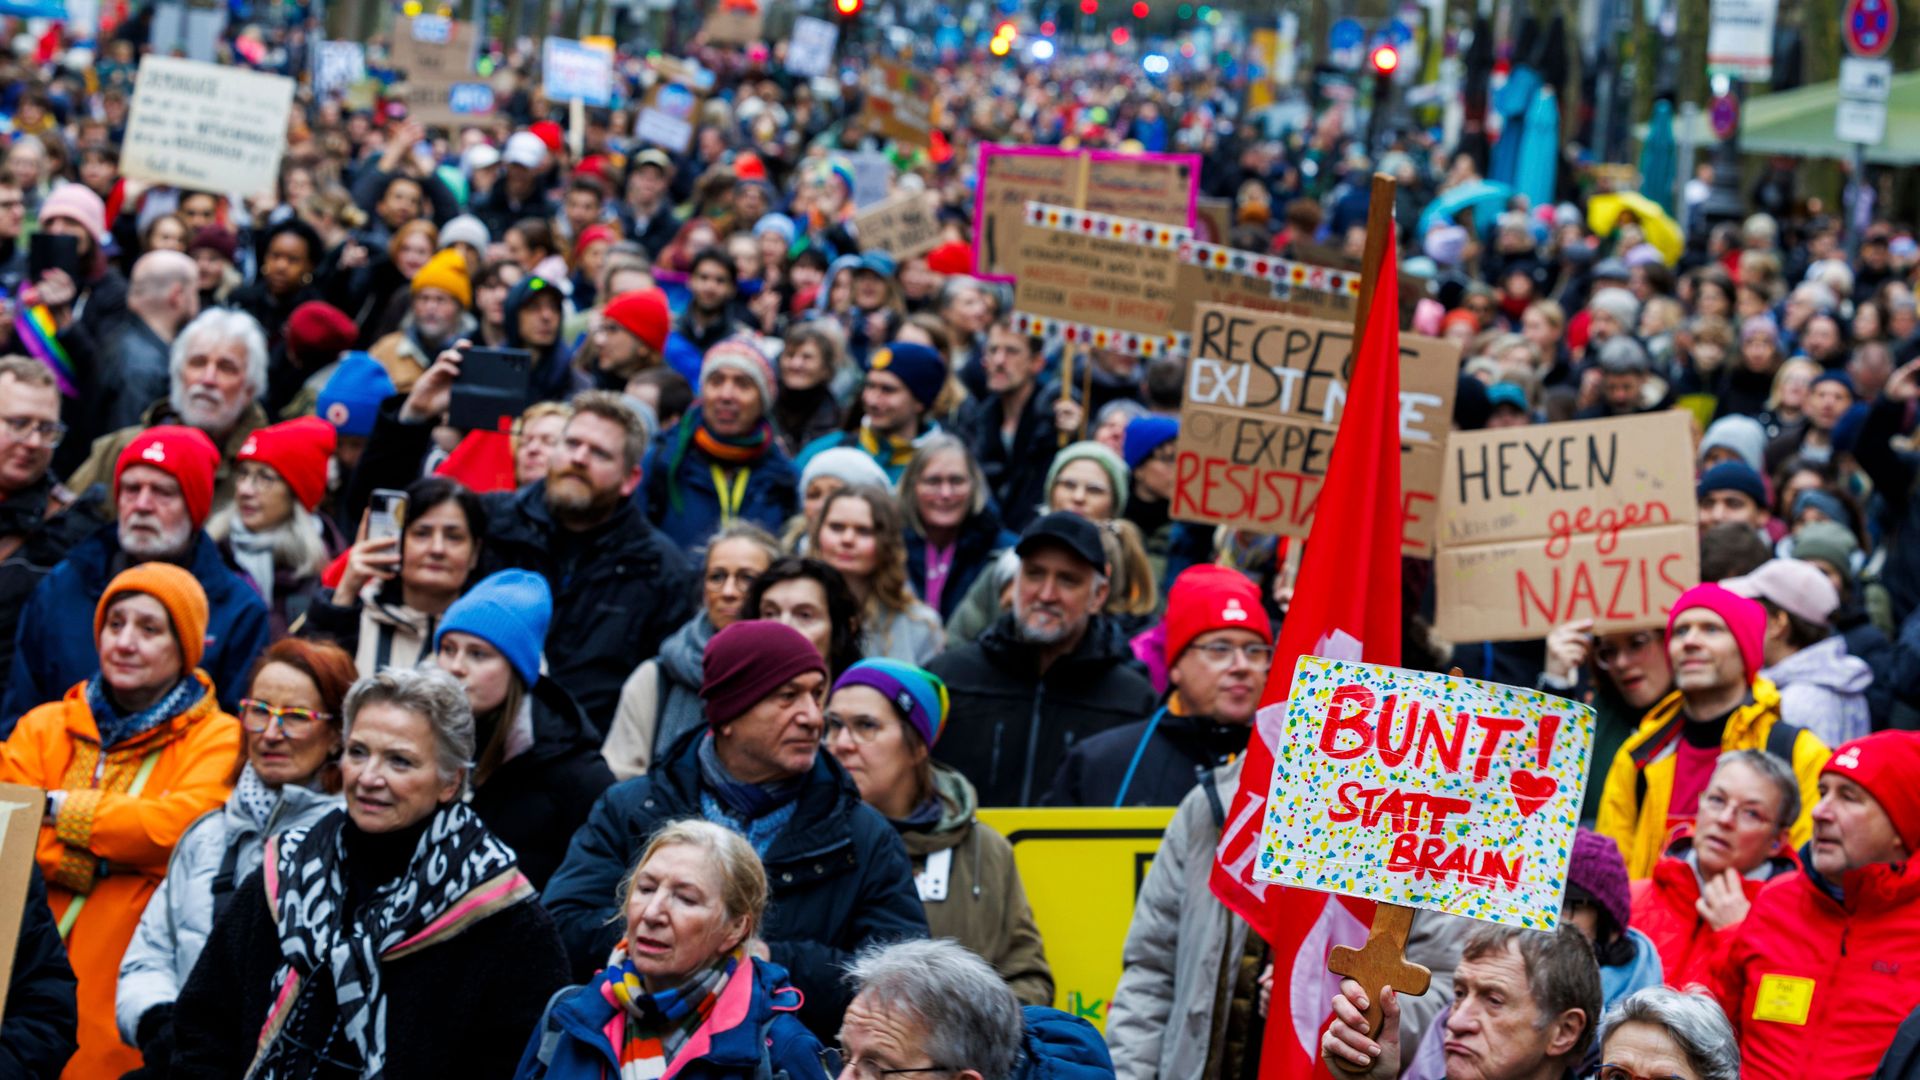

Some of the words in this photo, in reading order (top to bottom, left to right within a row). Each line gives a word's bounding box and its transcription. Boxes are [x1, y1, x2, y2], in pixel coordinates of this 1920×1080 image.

[1199, 311, 1419, 416] RESPE
[1231, 419, 1412, 475] EXPE
[1457, 432, 1618, 504] HEXEN
[1172, 452, 1436, 547] RESISTE
[1544, 501, 1670, 559] gegen
[1516, 553, 1685, 628] NAZIS
[1328, 781, 1472, 835] STATT
[1386, 833, 1525, 893] BRAUN
